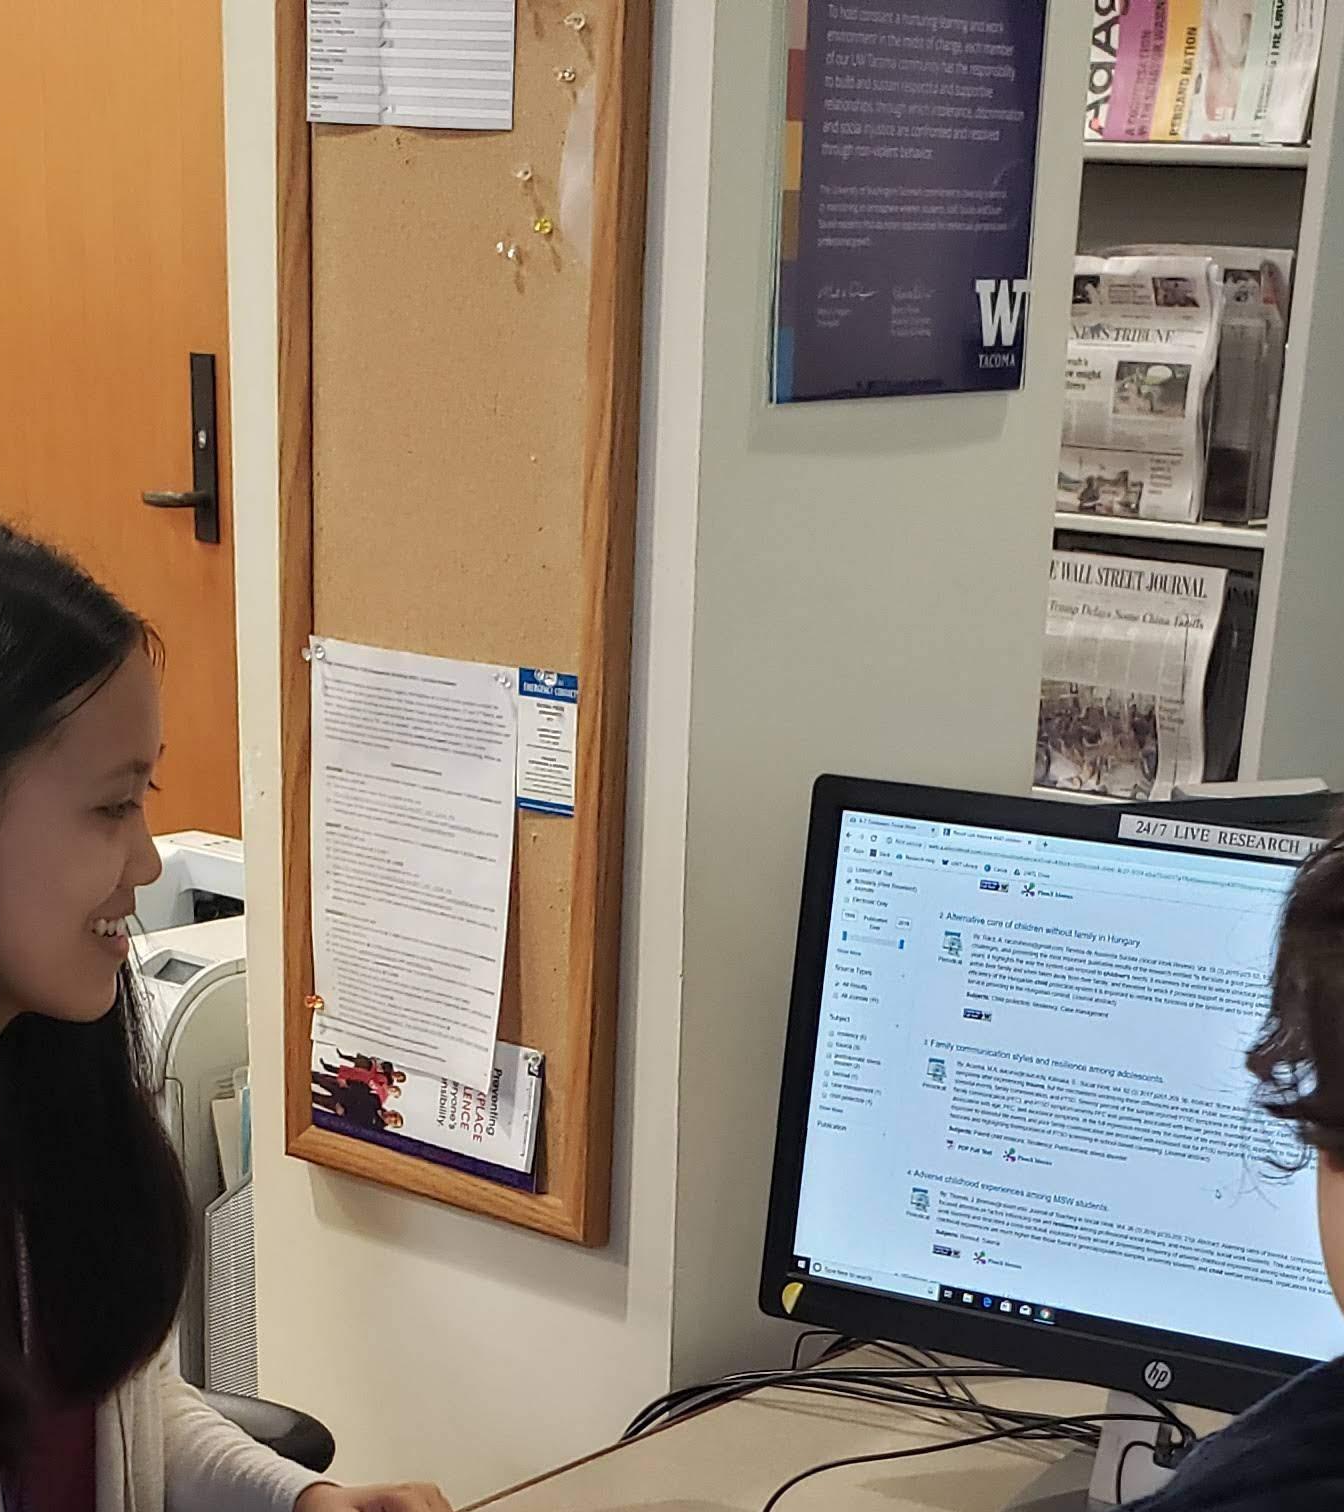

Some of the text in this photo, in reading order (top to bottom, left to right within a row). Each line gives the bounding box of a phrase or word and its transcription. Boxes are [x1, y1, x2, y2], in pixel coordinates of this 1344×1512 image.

[1180, 26, 1197, 76] NATION
[975, 279, 1032, 347] W
[978, 353, 1016, 369] TACOMA
[1060, 560, 1093, 585] WALL
[1095, 567, 1145, 592] STREET
[1136, 820, 1168, 837] 24/7
[1174, 825, 1211, 842] LIVE
[1218, 831, 1301, 854] RESEARCH
[946, 911, 1141, 949] Alternative care of children without family in Hungary
[929, 1039, 954, 1052] Family
[956, 1043, 1011, 1060] communication
[1012, 1049, 1034, 1064] styles
[1035, 1054, 1050, 1065] and
[1052, 1056, 1087, 1073] resilience
[1088, 1064, 1115, 1078] among
[485, 1067, 504, 1137] Preventing
[914, 1169, 943, 1183] Adverse
[944, 1175, 980, 1190] childhood
[981, 1181, 1025, 1197] experiences
[1026, 1190, 1052, 1203] among
[1053, 1194, 1075, 1207] MSW
